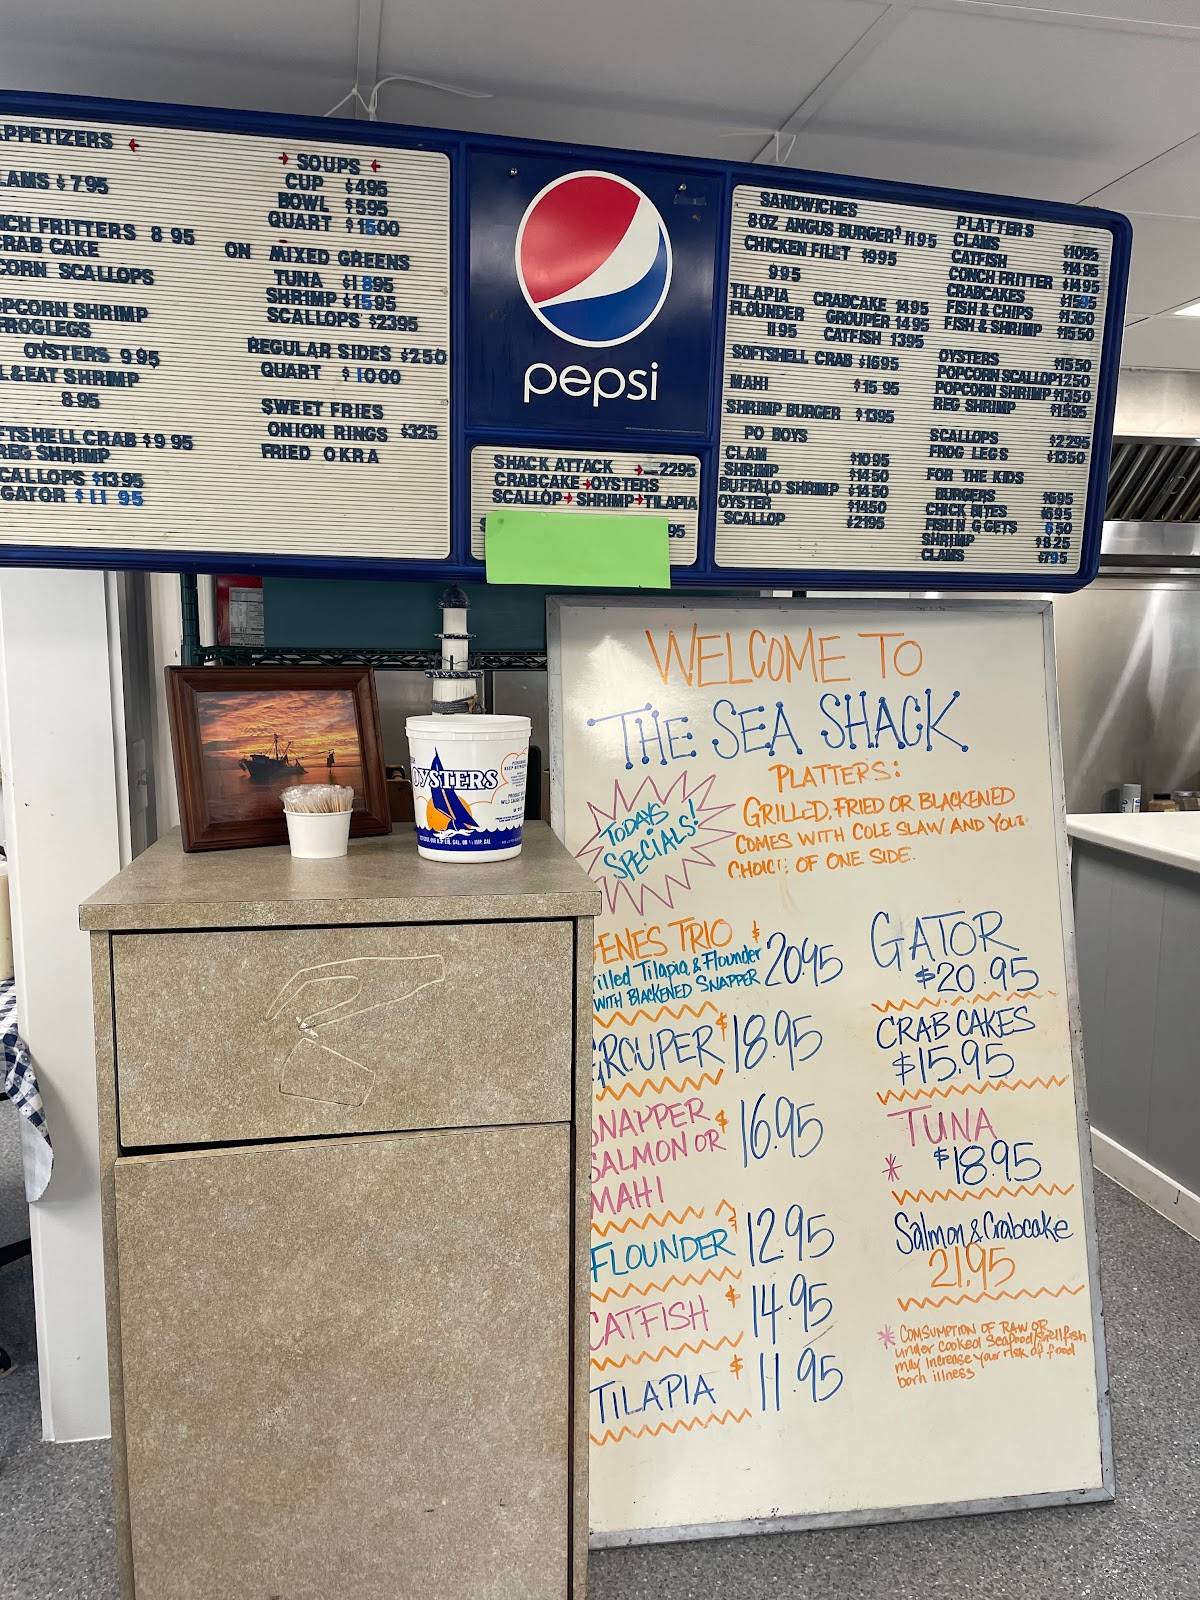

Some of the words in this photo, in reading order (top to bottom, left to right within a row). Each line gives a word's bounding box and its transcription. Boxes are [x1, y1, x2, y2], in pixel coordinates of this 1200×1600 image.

[297, 153, 361, 175] SOUPS
[285, 173, 324, 191] CUP
[278, 192, 330, 212] BOWL
[760, 191, 858, 217] SANDWICHES
[39, 217, 137, 241] FRITTERS
[268, 211, 332, 232] QUART
[785, 217, 834, 236] ANGUS
[838, 223, 894, 243] BURGER
[956, 216, 1034, 237] PLATTERS
[0, 235, 43, 252] RAB
[50, 238, 99, 257] CAKE
[744, 235, 807, 256] CHICKEN
[811, 242, 851, 260] FILET
[954, 232, 1000, 250] CLAMS
[224, 241, 251, 259] ON
[269, 245, 330, 265] MIXED
[338, 250, 410, 271] GREENS
[952, 250, 1007, 268] CATFISH
[58, 263, 154, 285] SCALLOPS
[274, 269, 324, 288] TUNA
[949, 266, 995, 284] CONCH
[999, 271, 1053, 289] FRITTER
[266, 287, 338, 307] SHRIMP
[730, 282, 789, 302] TILAPIA
[813, 292, 887, 311] CRABCAKE
[947, 283, 1025, 303] CRABCAKES
[73, 303, 149, 322] SHRIMP
[267, 307, 361, 328] SCALLOPS
[730, 300, 805, 321] FLOUNDER
[826, 309, 890, 328] GROUPER
[947, 300, 977, 315] FISH
[980, 303, 990, 316] &
[993, 304, 1033, 320] CHIPS
[824, 327, 882, 345] CATFISH
[944, 316, 975, 331] FISH
[978, 319, 987, 333] &
[990, 320, 1042, 336] SHRIMP
[24, 341, 110, 363] OYSTERS
[248, 337, 331, 359] REGULAR
[338, 344, 391, 362] SIDES
[732, 344, 808, 364] SOFTSHELL
[815, 351, 853, 367] CRAB
[939, 349, 999, 366] OYSTERS
[63, 368, 139, 387] SHRIMP
[261, 362, 321, 380] QUART
[937, 365, 999, 382] POPCORN
[1001, 369, 1056, 385] SCALLOP
[524, 361, 659, 407] pepsi
[730, 374, 769, 390] MAHI
[935, 381, 997, 398] POPCORN
[1000, 385, 1050, 400] SHRIMP
[261, 398, 323, 416] SWEET
[330, 401, 384, 419] FRIES
[726, 400, 783, 416] SHRIMP
[786, 403, 841, 420] BURGER
[934, 396, 961, 411] REG
[965, 399, 1016, 414] SHRIMP
[83, 430, 137, 448] CRAB
[267, 421, 325, 439] ONION
[333, 424, 388, 442] RINGS
[744, 425, 764, 440] PO
[772, 427, 808, 442] BOYS
[930, 428, 999, 444] SCALLOPS
[37, 446, 110, 463] SHRIMP
[261, 443, 311, 461] FRIED
[324, 446, 379, 463] OKRA
[725, 446, 767, 461] CLAM
[929, 444, 965, 458] FROG
[971, 447, 1009, 461] LEGS
[494, 454, 549, 471] SHACK
[554, 457, 613, 474] ATTACK
[724, 462, 779, 477] SHRIMP
[494, 472, 580, 489] CRABCAKE
[591, 476, 659, 492] OYSTERS
[719, 477, 782, 495] BUFFALO
[786, 480, 839, 496] SHRIMP
[927, 468, 953, 481] FOR
[963, 469, 988, 482] THE
[993, 471, 1024, 484] KIDS
[1, 487, 66, 502] GATOR
[492, 488, 562, 504] SCALLOP
[576, 491, 634, 507] SHRIMP
[643, 494, 698, 510] TILAPIA
[718, 495, 771, 510] OYSTER
[723, 511, 786, 526] SCALLOP
[922, 533, 975, 548] SHRIMP
[921, 548, 965, 561] CLAMS
[645, 623, 852, 687] WELCOME
[858, 632, 923, 678] TO
[587, 702, 697, 770] THE
[711, 699, 803, 760] SEA
[820, 688, 969, 752] SHACK
[412, 767, 498, 790] OYSTERS
[768, 760, 902, 793] PLATTERS:
[833, 797, 885, 818] FRIED
[888, 793, 914, 813] OR
[919, 786, 1016, 811] BLACKENED
[735, 832, 793, 855] COMES
[798, 826, 846, 846] WITH
[852, 822, 892, 841] COLE
[895, 817, 945, 837] SLAW
[949, 815, 985, 835] AND
[795, 854, 819, 874] OF
[826, 850, 864, 871] ONE
[667, 916, 733, 954] TRIO
[871, 910, 1020, 971] GATOR
[633, 959, 690, 984] Tilapia
[693, 958, 703, 974] &
[701, 944, 762, 971] Flounder
[594, 991, 624, 1012] WITH
[626, 983, 693, 1006] BLACKENED
[696, 969, 761, 992] SNAPPER
[876, 1012, 952, 1049] CRAB
[955, 1005, 1036, 1038] CAKES
[892, 1039, 1015, 1086] $15.95
[887, 1104, 998, 1147] TUNA
[694, 1128, 727, 1152] OR
[591, 1175, 665, 1220] MAHI
[894, 1211, 965, 1255] Salmon
[970, 1218, 983, 1244] &
[983, 1209, 1074, 1243] Crabcake
[590, 1228, 737, 1283] FLOUNDER
[981, 1321, 996, 1334] OF
[999, 1320, 1028, 1334] RAW
[1031, 1319, 1048, 1331] OR
[895, 1359, 920, 1375] may
[933, 1367, 976, 1382] illness
[590, 1373, 717, 1424] TILAPIA
